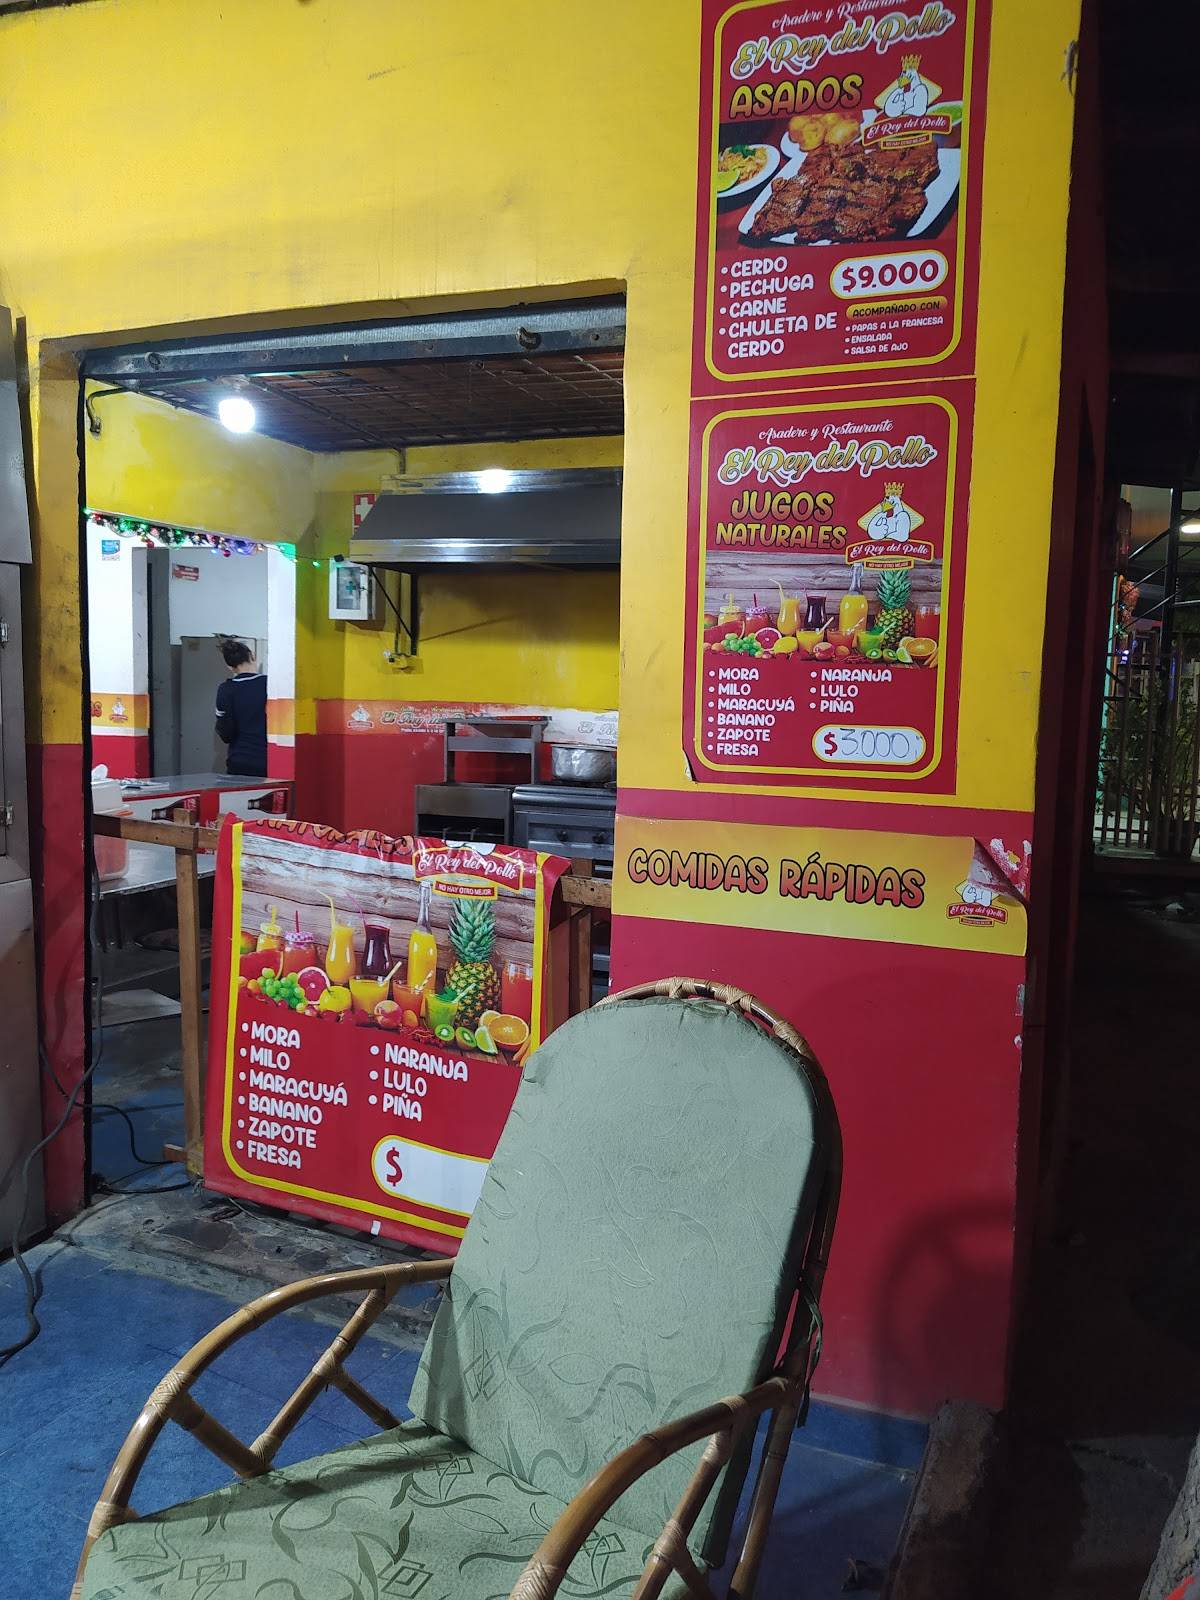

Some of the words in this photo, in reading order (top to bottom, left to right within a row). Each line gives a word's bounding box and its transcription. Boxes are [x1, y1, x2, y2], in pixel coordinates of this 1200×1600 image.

[772, 10, 823, 32] Asadero
[825, 10, 833, 22] y
[730, 36, 767, 80] El
[769, 34, 828, 74] Rey
[829, 16, 874, 54] del
[874, 1, 956, 53] Pollo
[729, 73, 864, 119] ASADOS
[867, 124, 880, 139] El
[881, 122, 902, 135] Rey
[904, 118, 919, 128] del
[920, 116, 946, 128] Pollo
[730, 256, 788, 278] CERDO
[842, 259, 939, 292] $9.000
[730, 273, 814, 299] PECHUGA
[729, 297, 787, 319] CARNE
[853, 303, 916, 318] ACOMPAÑADO
[920, 301, 940, 311] CON
[728, 316, 809, 339] CHULETA
[815, 312, 838, 331] DE
[852, 322, 878, 332] PAPAS
[880, 321, 887, 330] A
[889, 320, 899, 329] LA
[902, 316, 944, 328] FRANCESA
[727, 338, 785, 359] CERDO
[850, 345, 876, 355] SALSA
[879, 344, 888, 353] DE
[891, 342, 909, 351] AJO
[851, 332, 892, 344] ENSALADA
[758, 426, 809, 445] Asadero
[810, 428, 819, 440] y
[822, 418, 894, 441] Restaurante
[718, 446, 754, 486] El
[756, 446, 813, 487] Rey
[813, 439, 858, 472] del
[858, 435, 938, 478] Pollo
[731, 490, 834, 522] JUGOS
[715, 523, 848, 549] NATURALES
[850, 545, 863, 558] El
[864, 544, 886, 556] Rey
[886, 543, 901, 552] del
[902, 543, 929, 555] Pollo
[718, 667, 759, 681] MORA
[821, 668, 892, 683] NARANJA
[717, 683, 751, 695] MILO
[820, 684, 859, 698] LULO
[717, 696, 795, 712] MARACUYÁ
[819, 697, 854, 713] PIÑA
[717, 713, 775, 727] BANANO
[717, 728, 770, 742] ZAPOTE
[716, 742, 759, 756] FRESA
[418, 854, 434, 871] El
[435, 853, 461, 873] Rey
[462, 856, 480, 870] del
[484, 861, 517, 880] Pollo
[627, 847, 769, 895] COMIDAS
[779, 852, 925, 908] RÁPIDAS
[438, 883, 446, 891] NO
[447, 885, 459, 893] HAY
[459, 887, 473, 895] OTRO
[950, 905, 959, 914] El
[250, 1021, 301, 1049] MORA
[250, 1046, 290, 1071] MILO
[385, 1042, 468, 1083] NARANJA
[249, 1071, 348, 1107] MARACUYÁ
[383, 1068, 427, 1098] LULO
[248, 1095, 323, 1126] BANANO
[383, 1093, 422, 1122] PIÑA
[248, 1116, 317, 1149] ZAPOTE
[247, 1141, 301, 1169] FRESA
[385, 1146, 403, 1187] $
